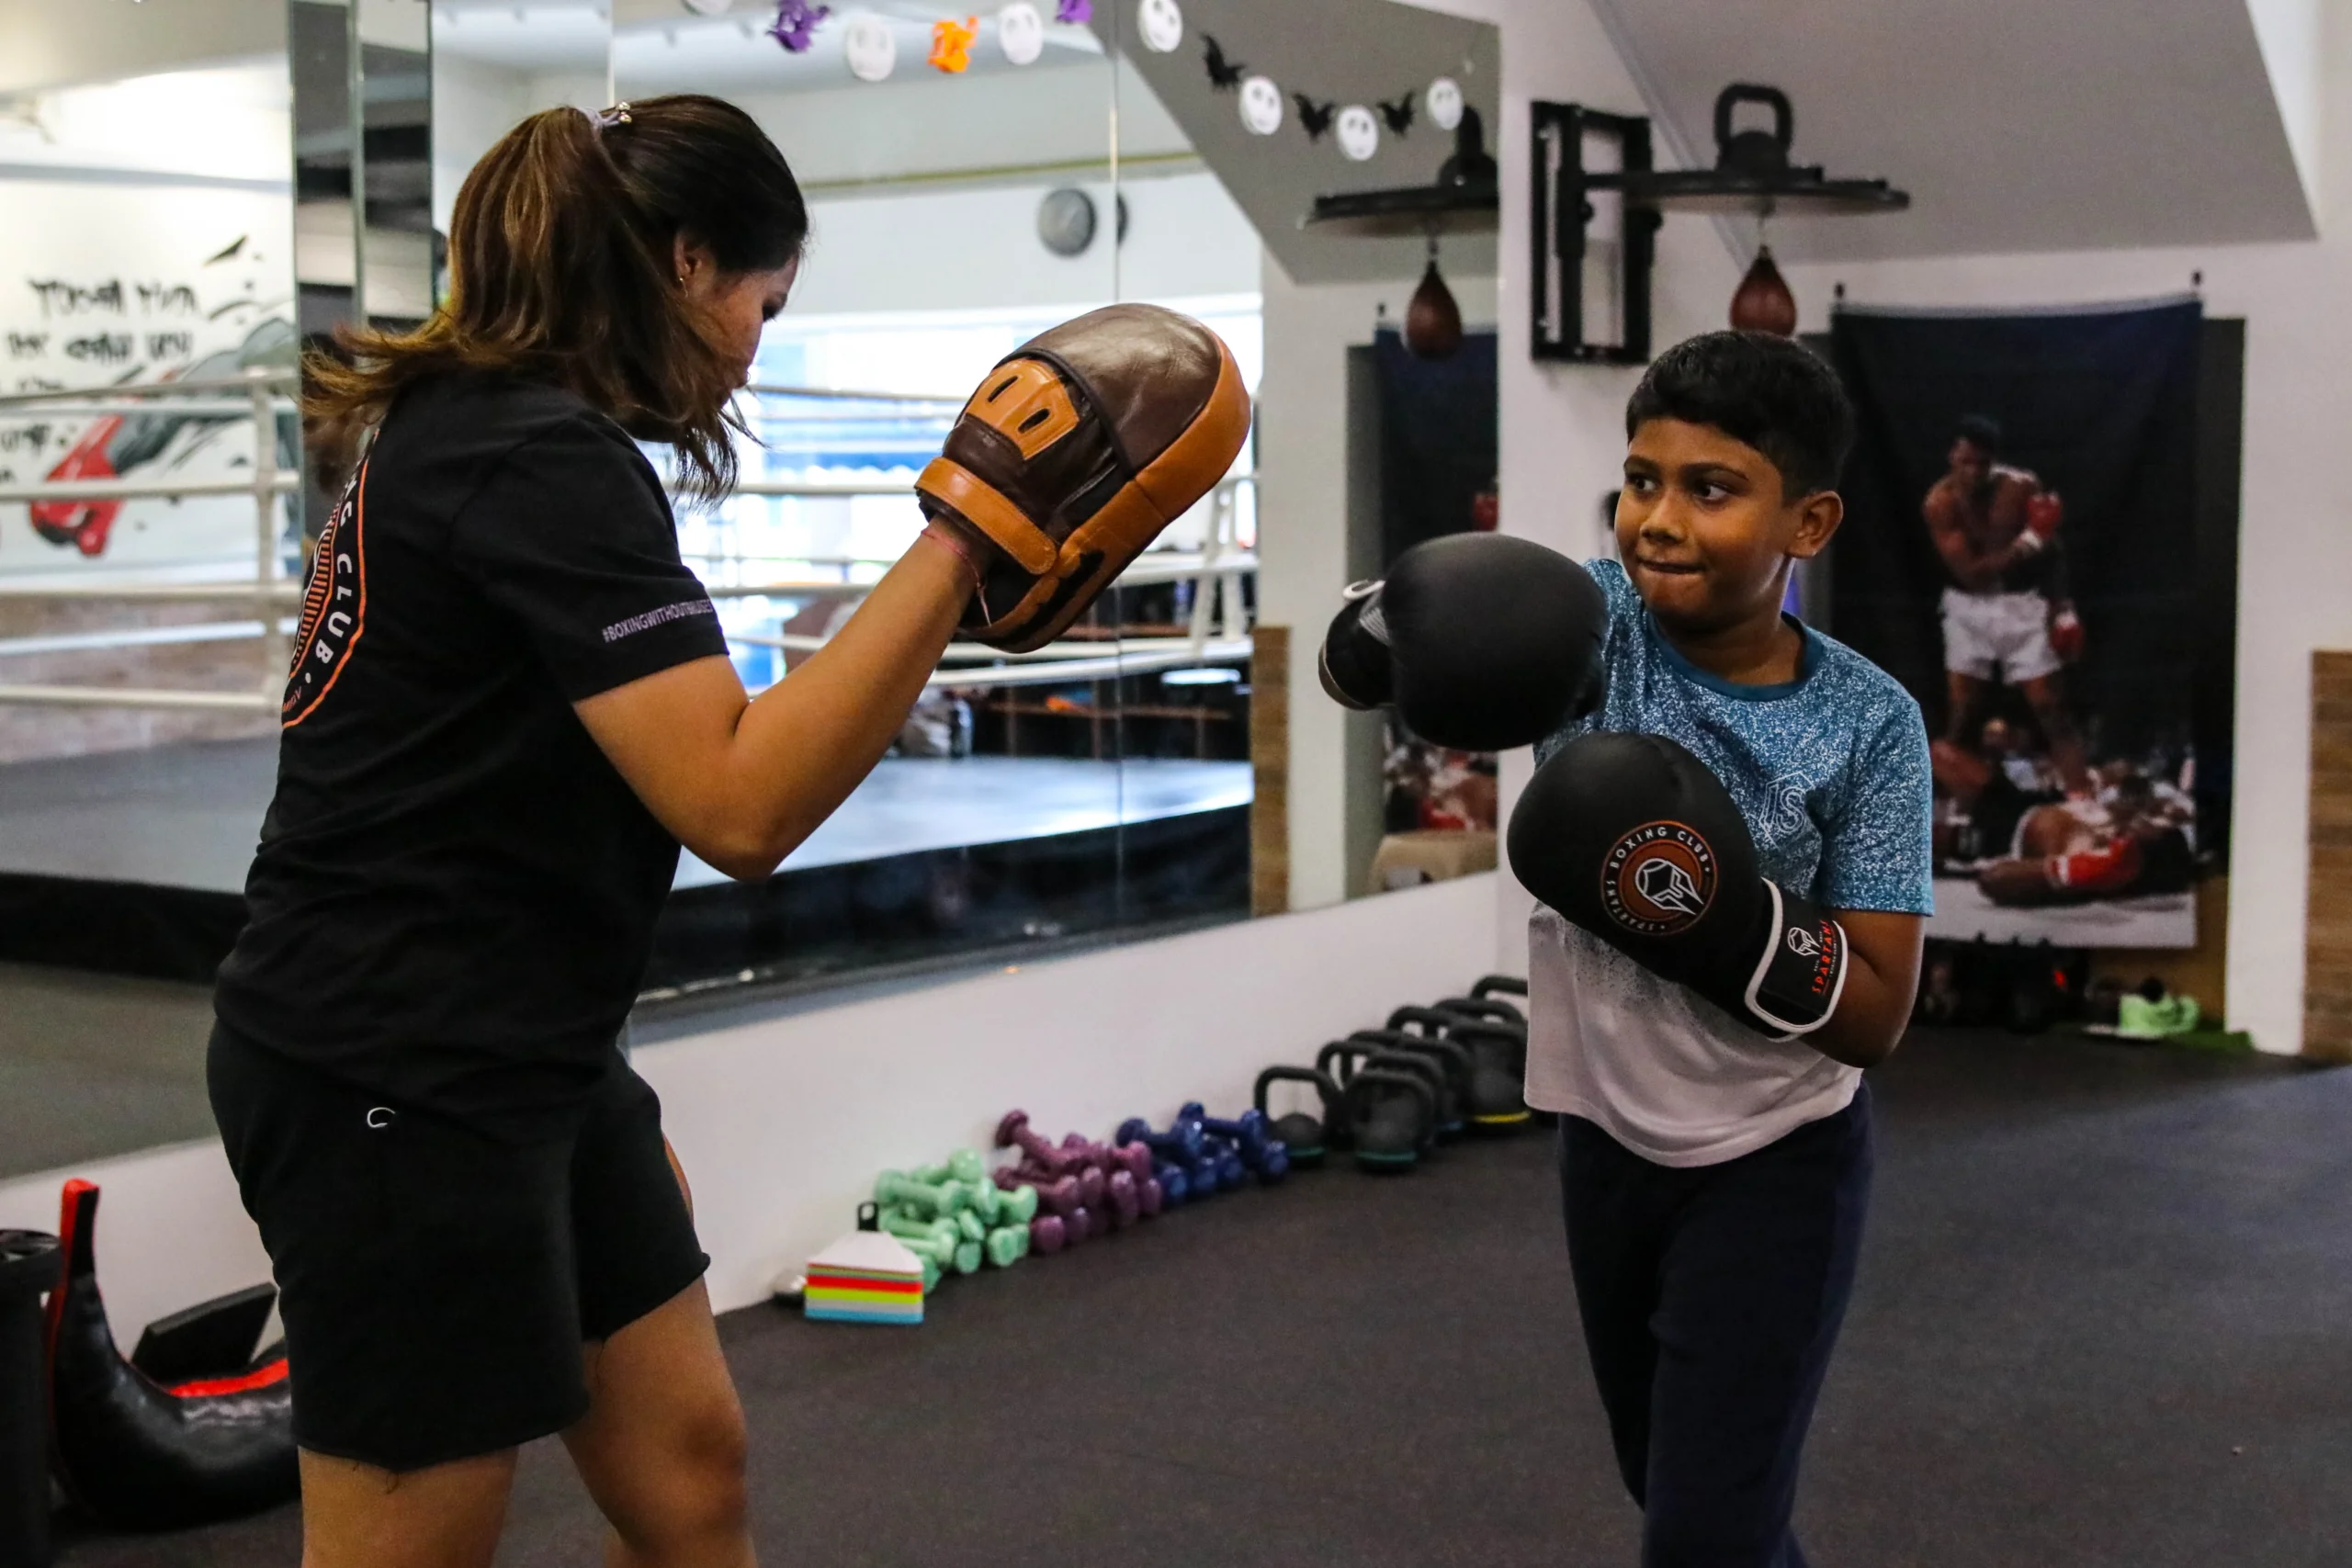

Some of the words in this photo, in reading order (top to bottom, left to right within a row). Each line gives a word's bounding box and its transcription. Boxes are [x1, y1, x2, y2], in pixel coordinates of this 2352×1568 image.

[1609, 827, 1668, 869] BOXING
[1677, 830, 1710, 863] CLUB
[1811, 919, 1833, 994] SPARTANS
